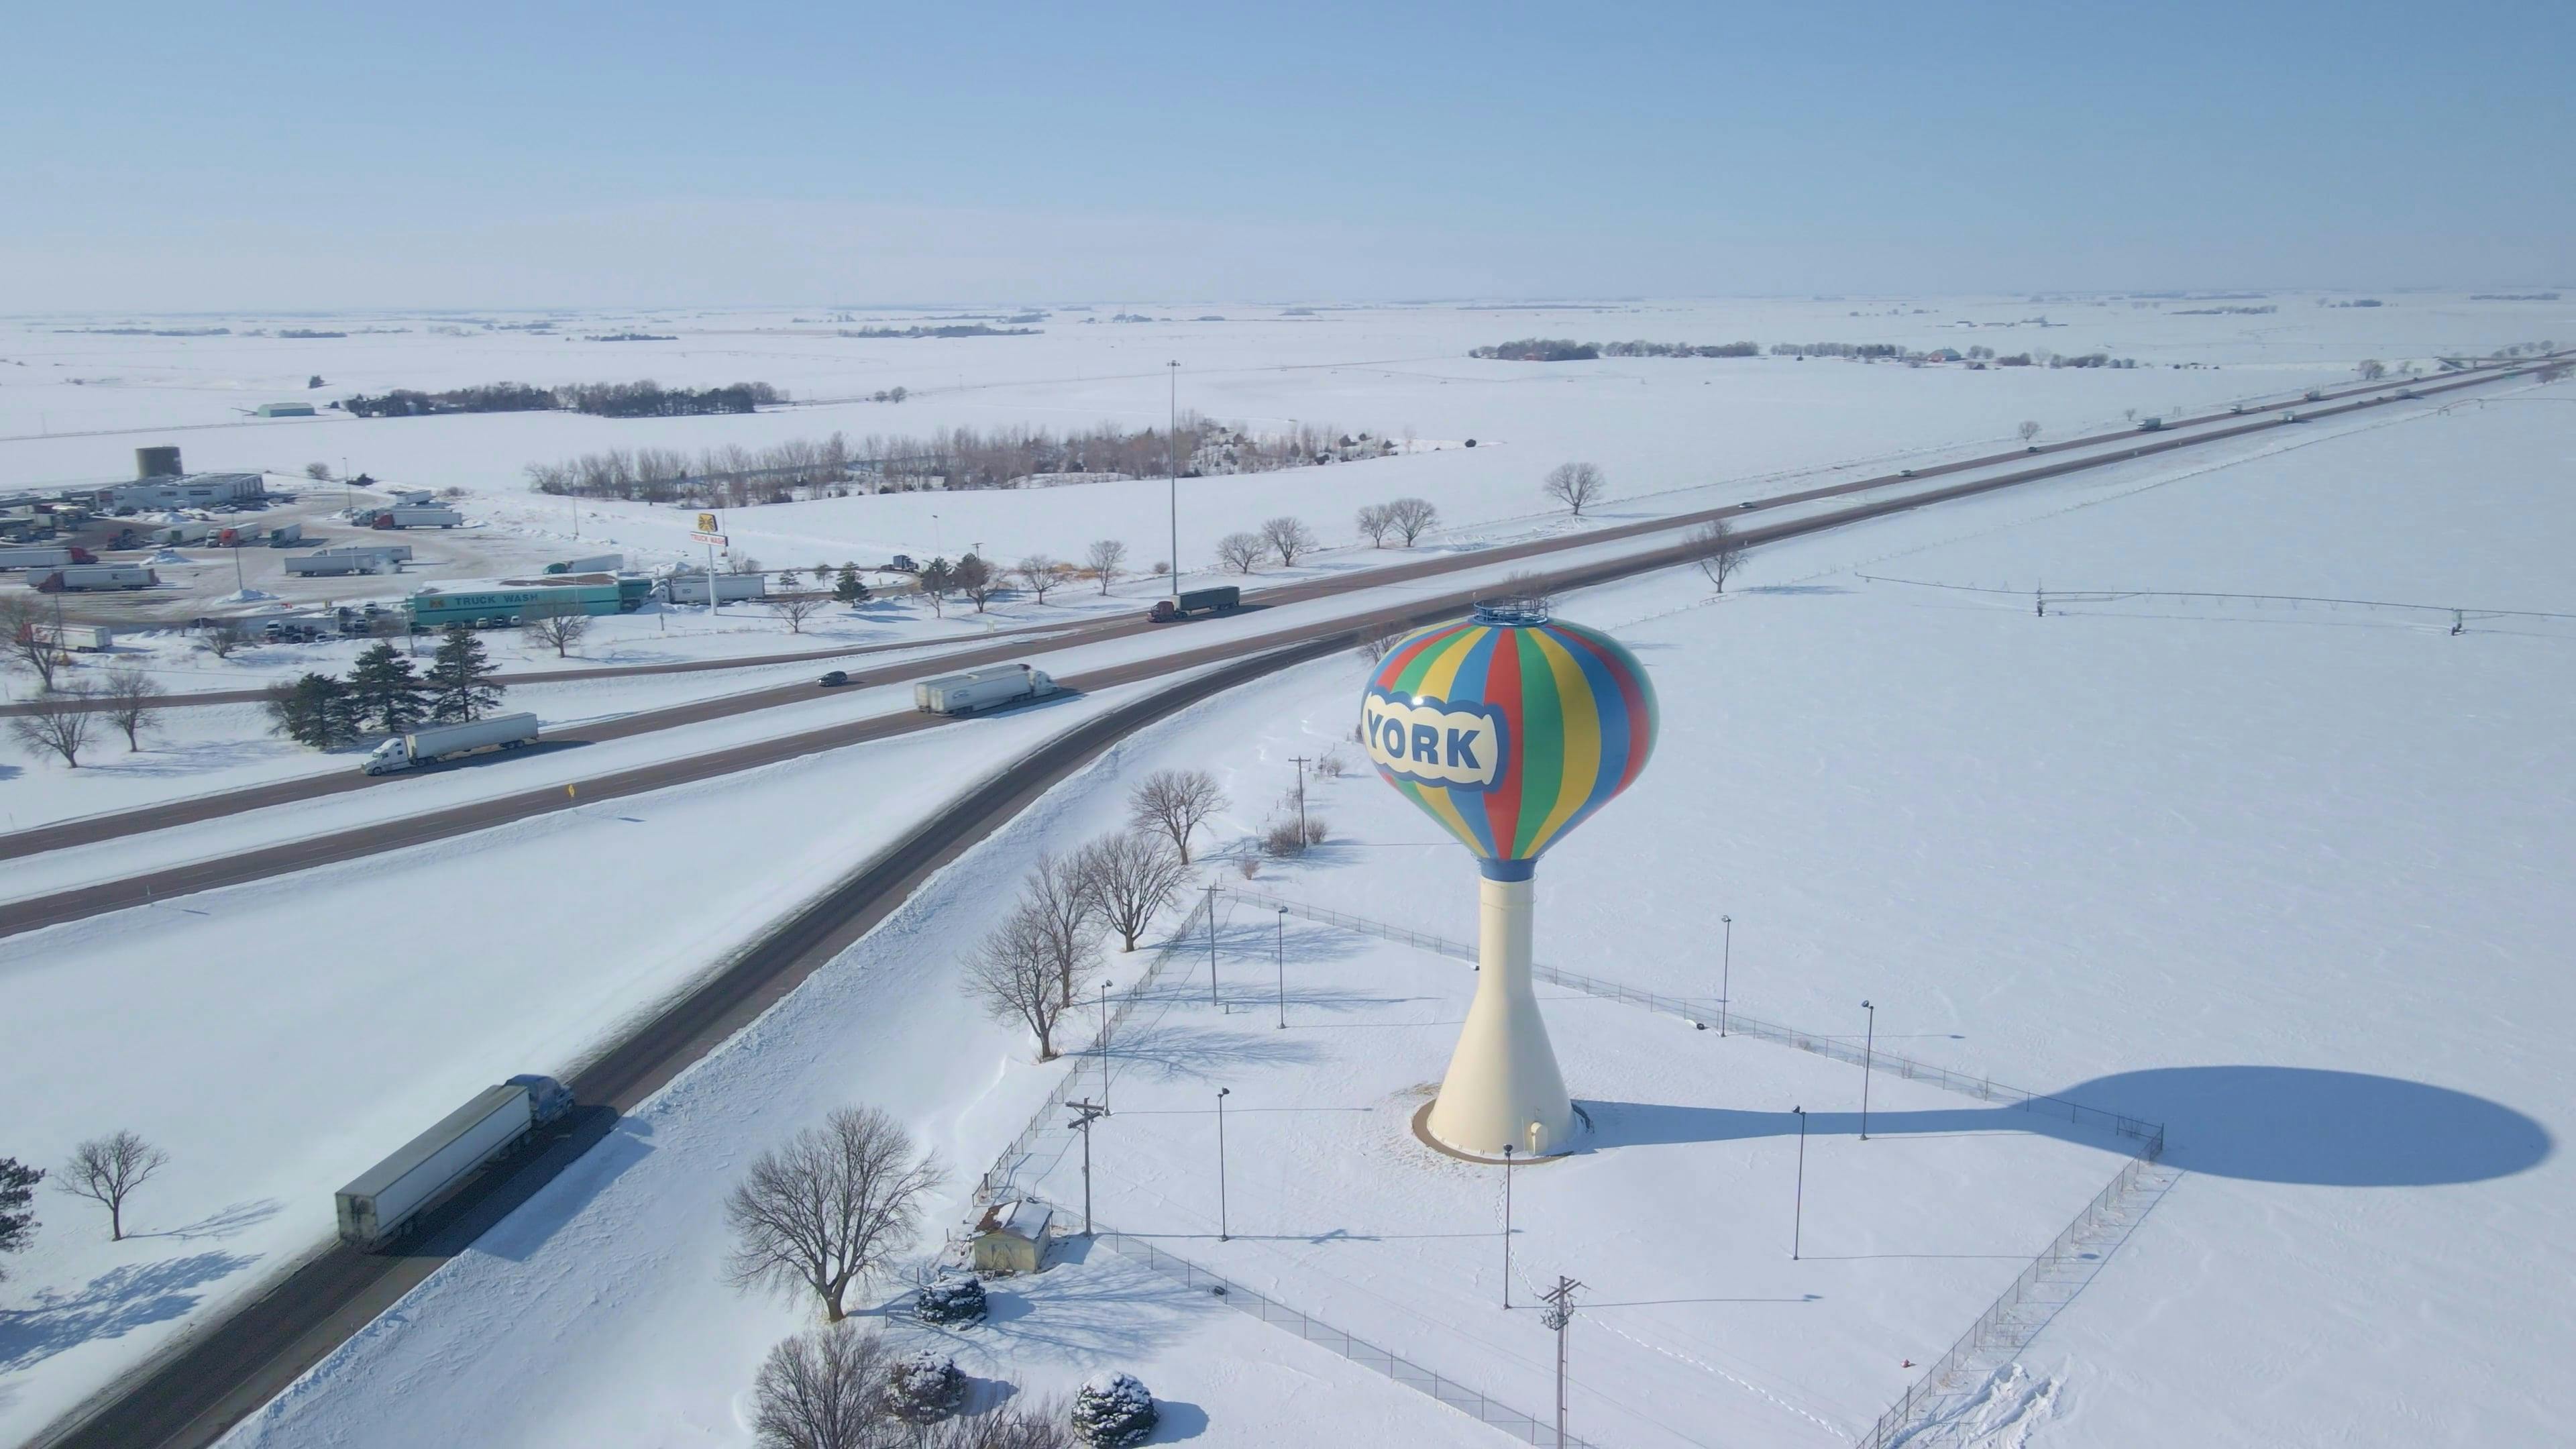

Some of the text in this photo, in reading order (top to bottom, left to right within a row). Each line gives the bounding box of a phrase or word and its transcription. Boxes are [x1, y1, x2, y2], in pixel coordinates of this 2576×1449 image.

[454, 594, 538, 606] TRUCK WASH
[1368, 708, 1481, 769] YORK
